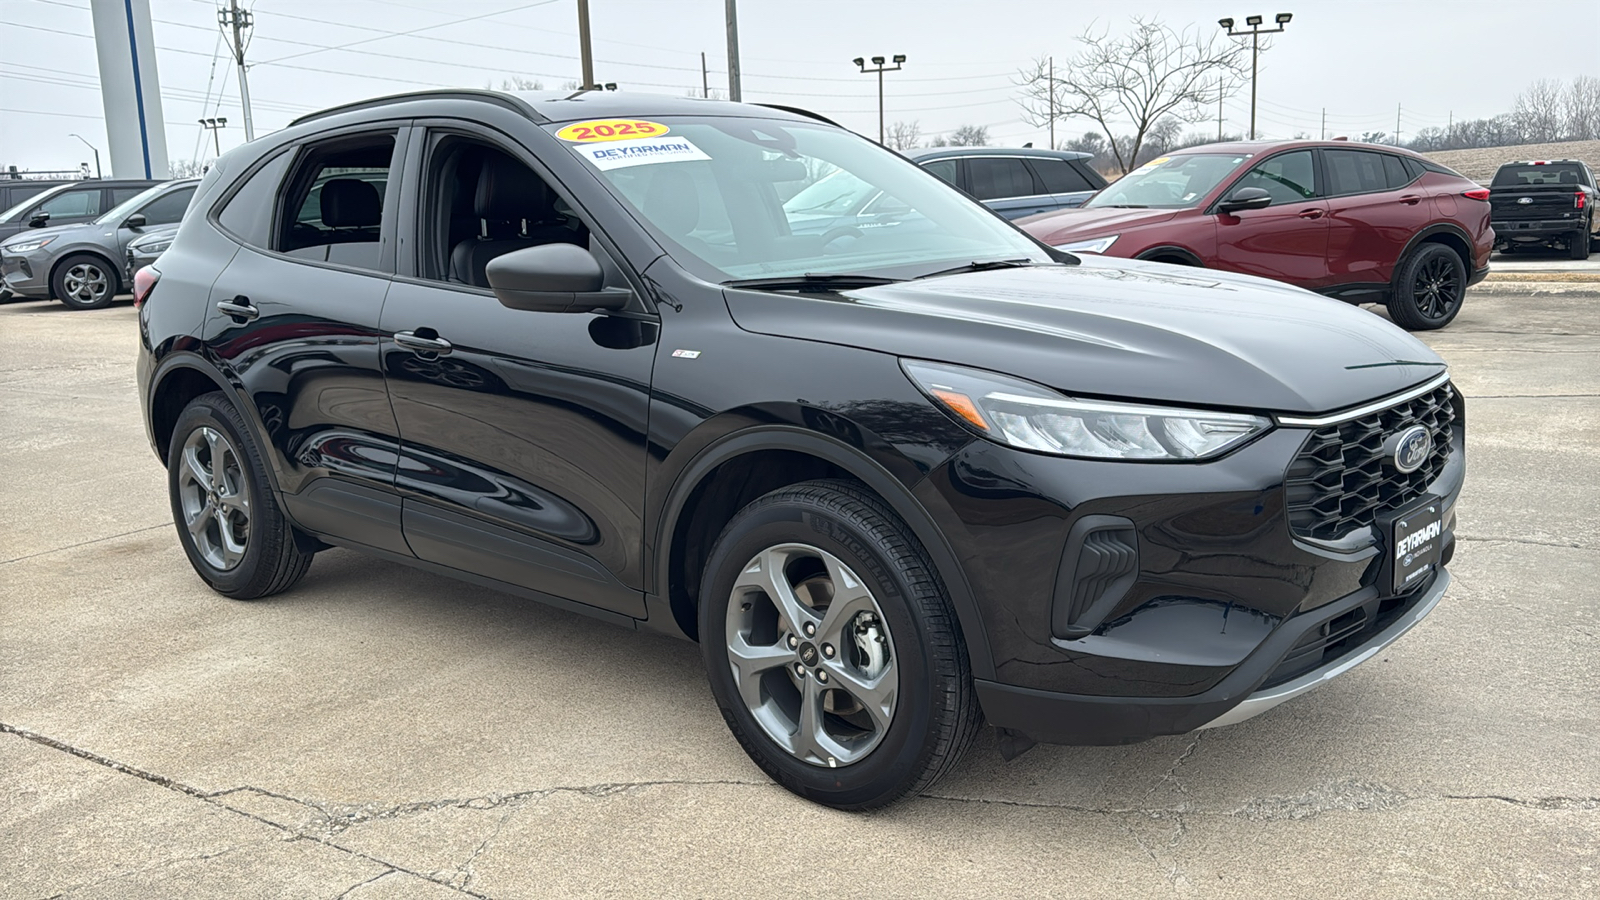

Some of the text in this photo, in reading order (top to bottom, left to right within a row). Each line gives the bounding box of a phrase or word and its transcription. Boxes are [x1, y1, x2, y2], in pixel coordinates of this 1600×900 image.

[572, 122, 657, 140] 2025
[592, 143, 690, 159] DEYARMAN
[1396, 519, 1441, 560] DEYARMAN
[831, 525, 896, 595] MICHELIN
